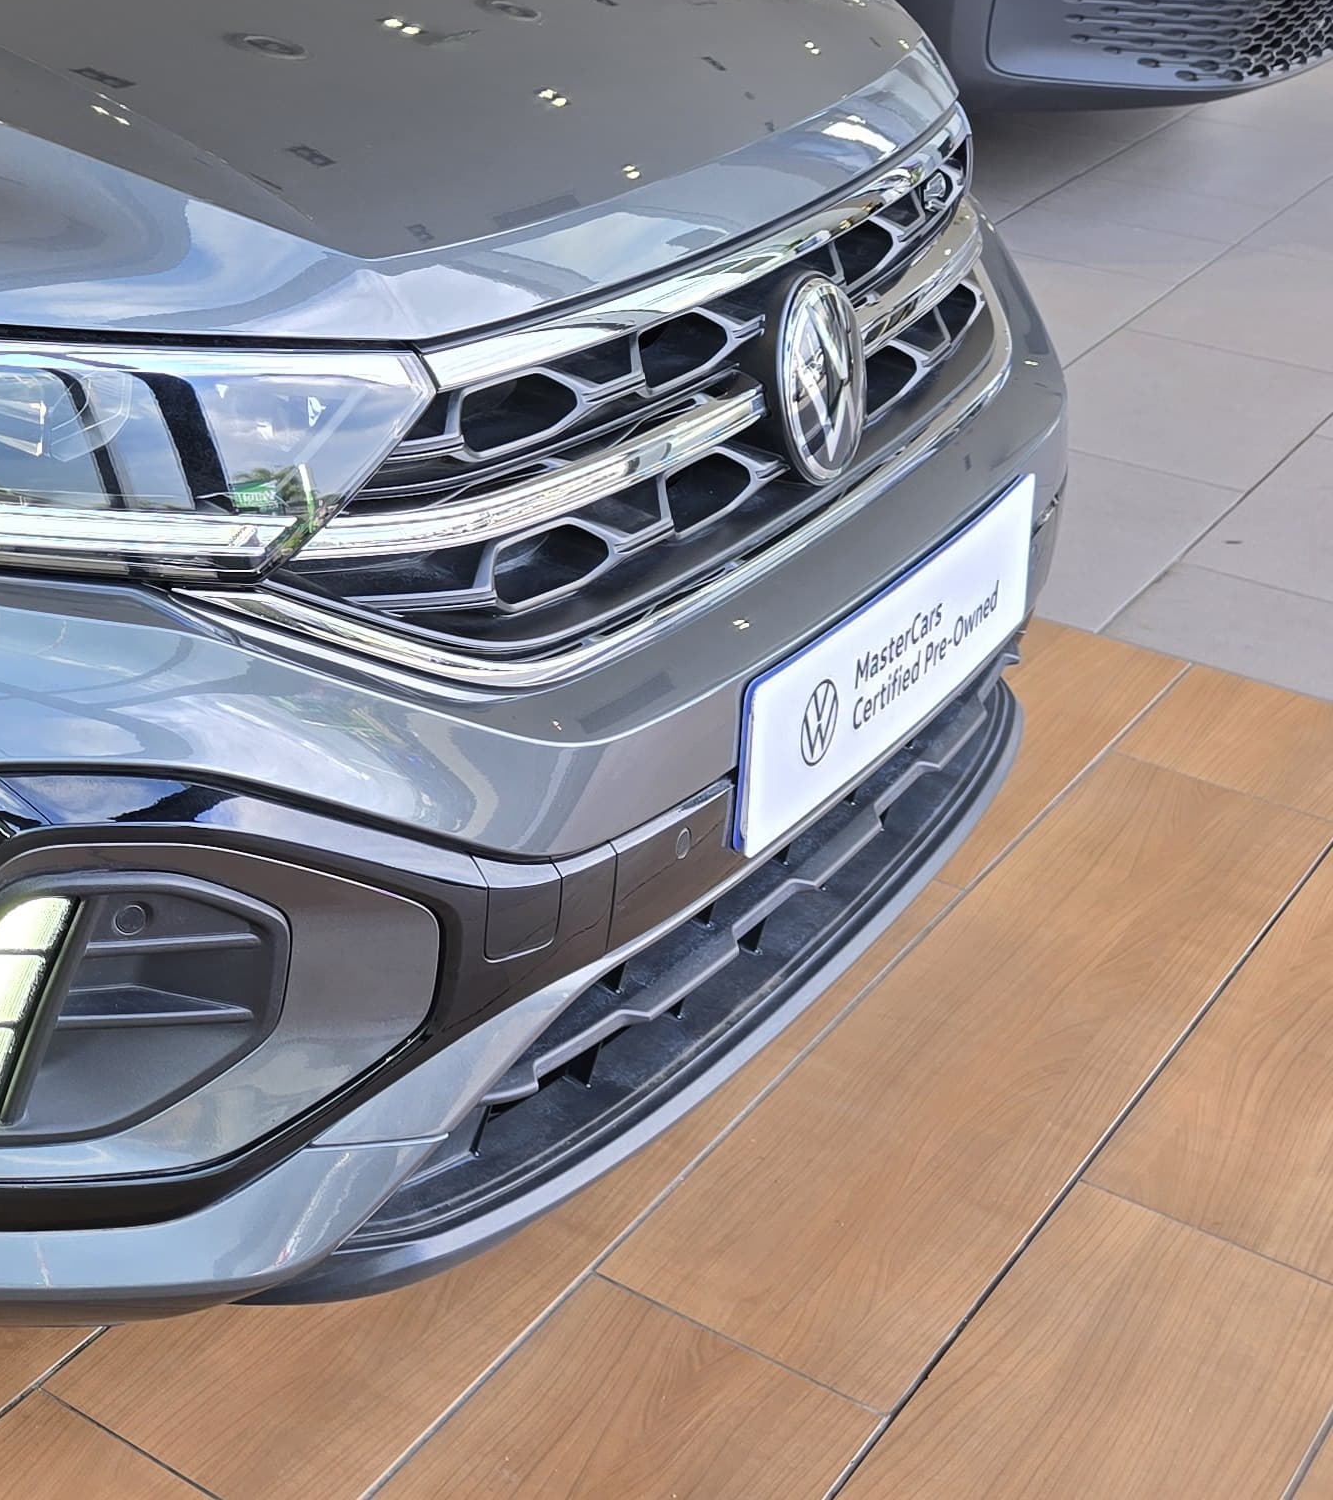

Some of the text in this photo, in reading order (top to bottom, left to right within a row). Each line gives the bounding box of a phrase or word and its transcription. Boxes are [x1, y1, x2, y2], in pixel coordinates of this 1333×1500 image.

[852, 579, 1001, 731] Certified Pre-Owned
[853, 601, 944, 690] MasterCars
